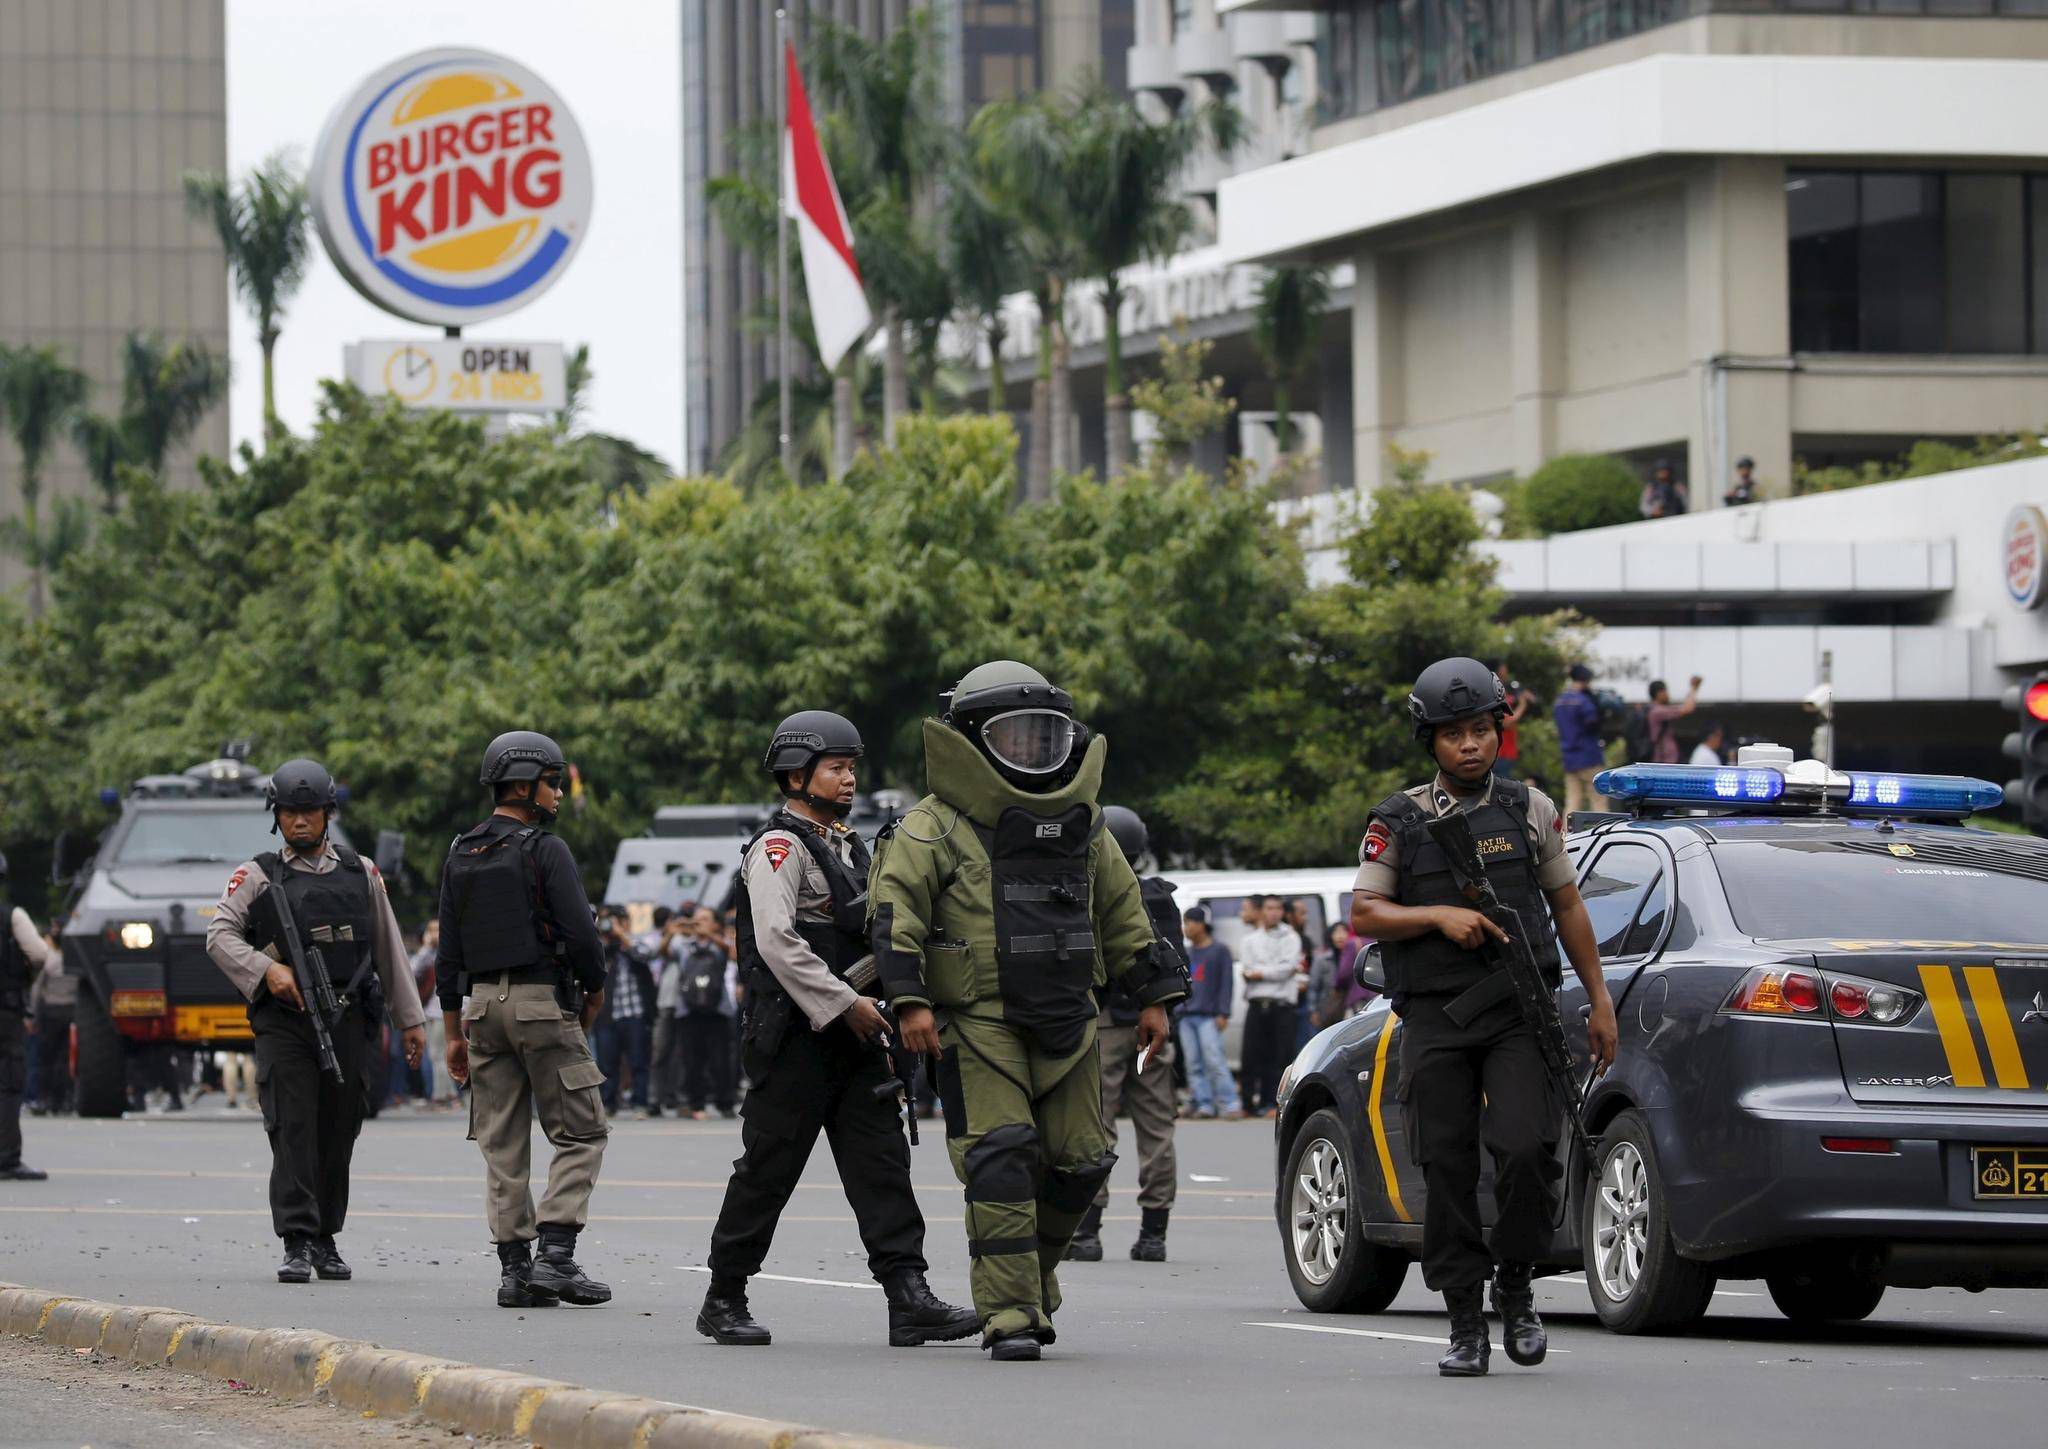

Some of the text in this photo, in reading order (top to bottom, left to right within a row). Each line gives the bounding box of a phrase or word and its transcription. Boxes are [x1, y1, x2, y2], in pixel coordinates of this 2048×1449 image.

[368, 103, 554, 190] BURGER
[378, 148, 561, 255] KING
[461, 347, 530, 373] OPEN
[448, 371, 482, 401] 24
[1477, 839, 1493, 848] SAT
[1896, 867, 1941, 875] Lautan
[1857, 1074, 1953, 1089] LANCER EX
[2023, 1172, 2048, 1192] 21
